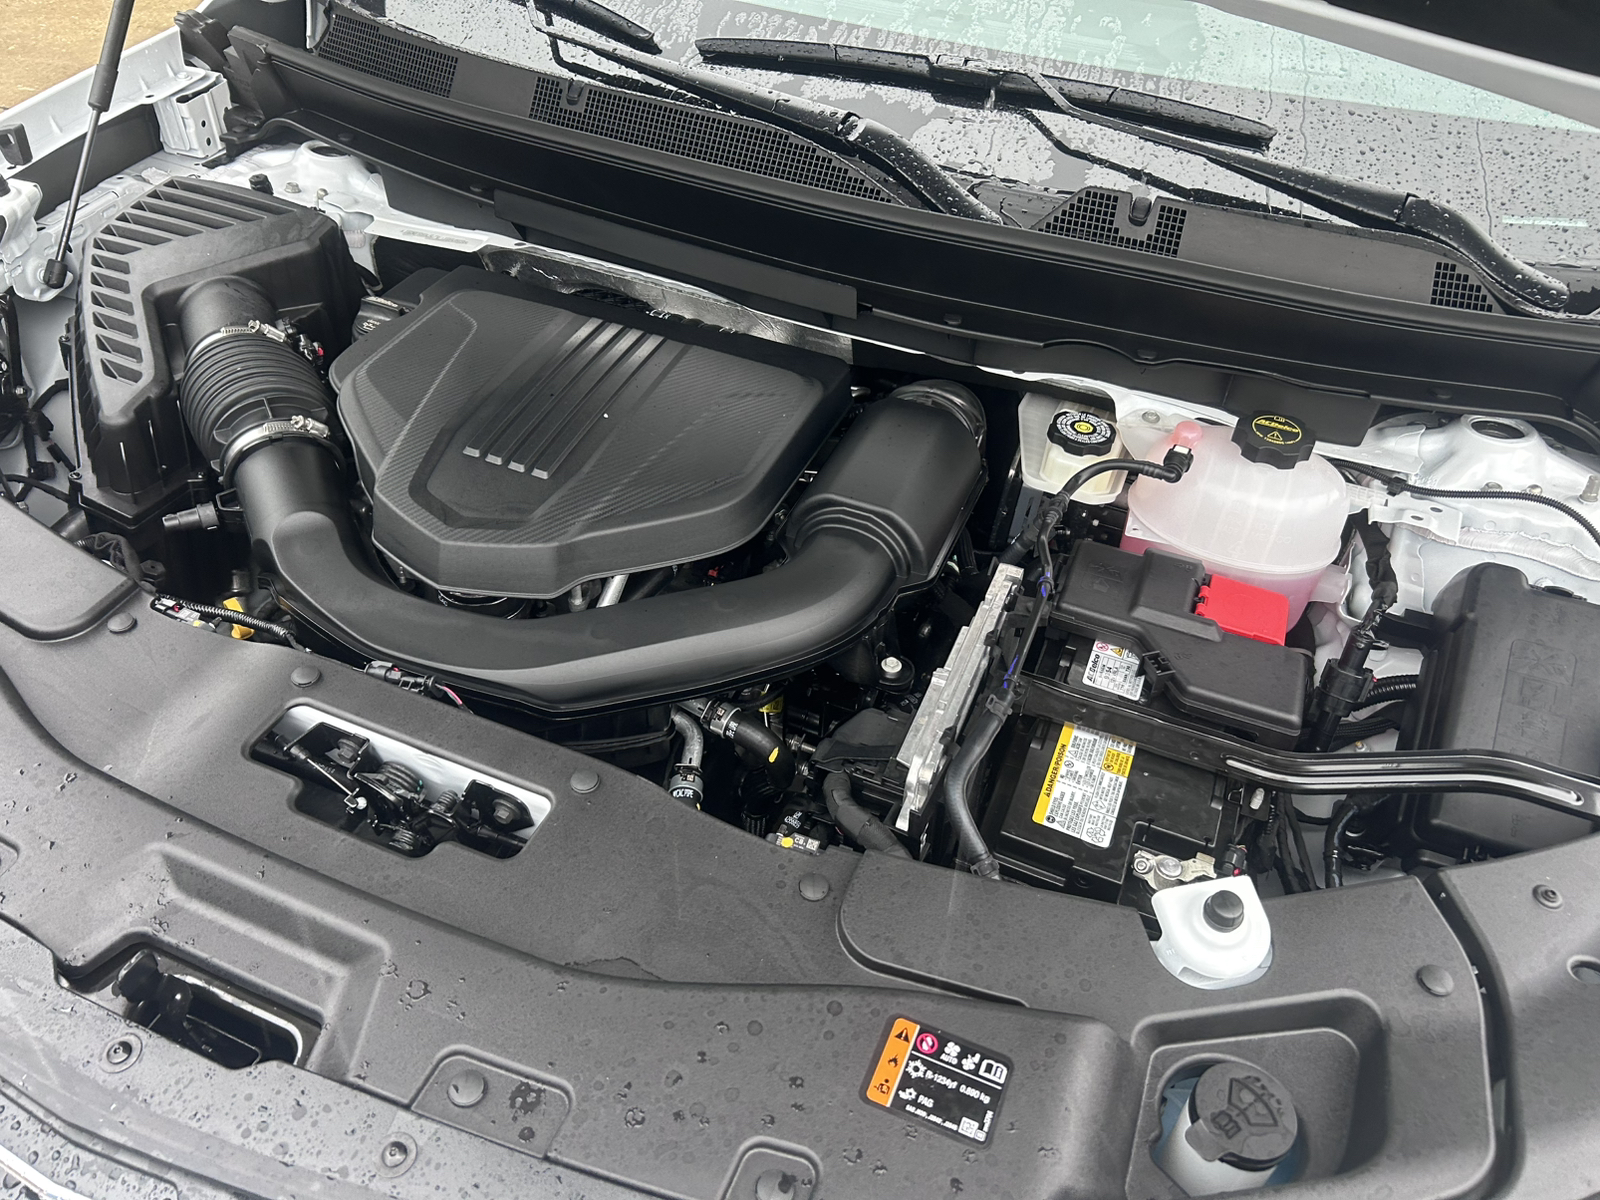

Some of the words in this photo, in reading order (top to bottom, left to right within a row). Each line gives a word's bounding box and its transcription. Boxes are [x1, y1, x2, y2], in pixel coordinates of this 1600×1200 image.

[1256, 419, 1299, 432] ACDelco
[1085, 653, 1100, 681] ACDelco
[940, 1054, 958, 1065] AUTO
[917, 1095, 935, 1108] PAG
